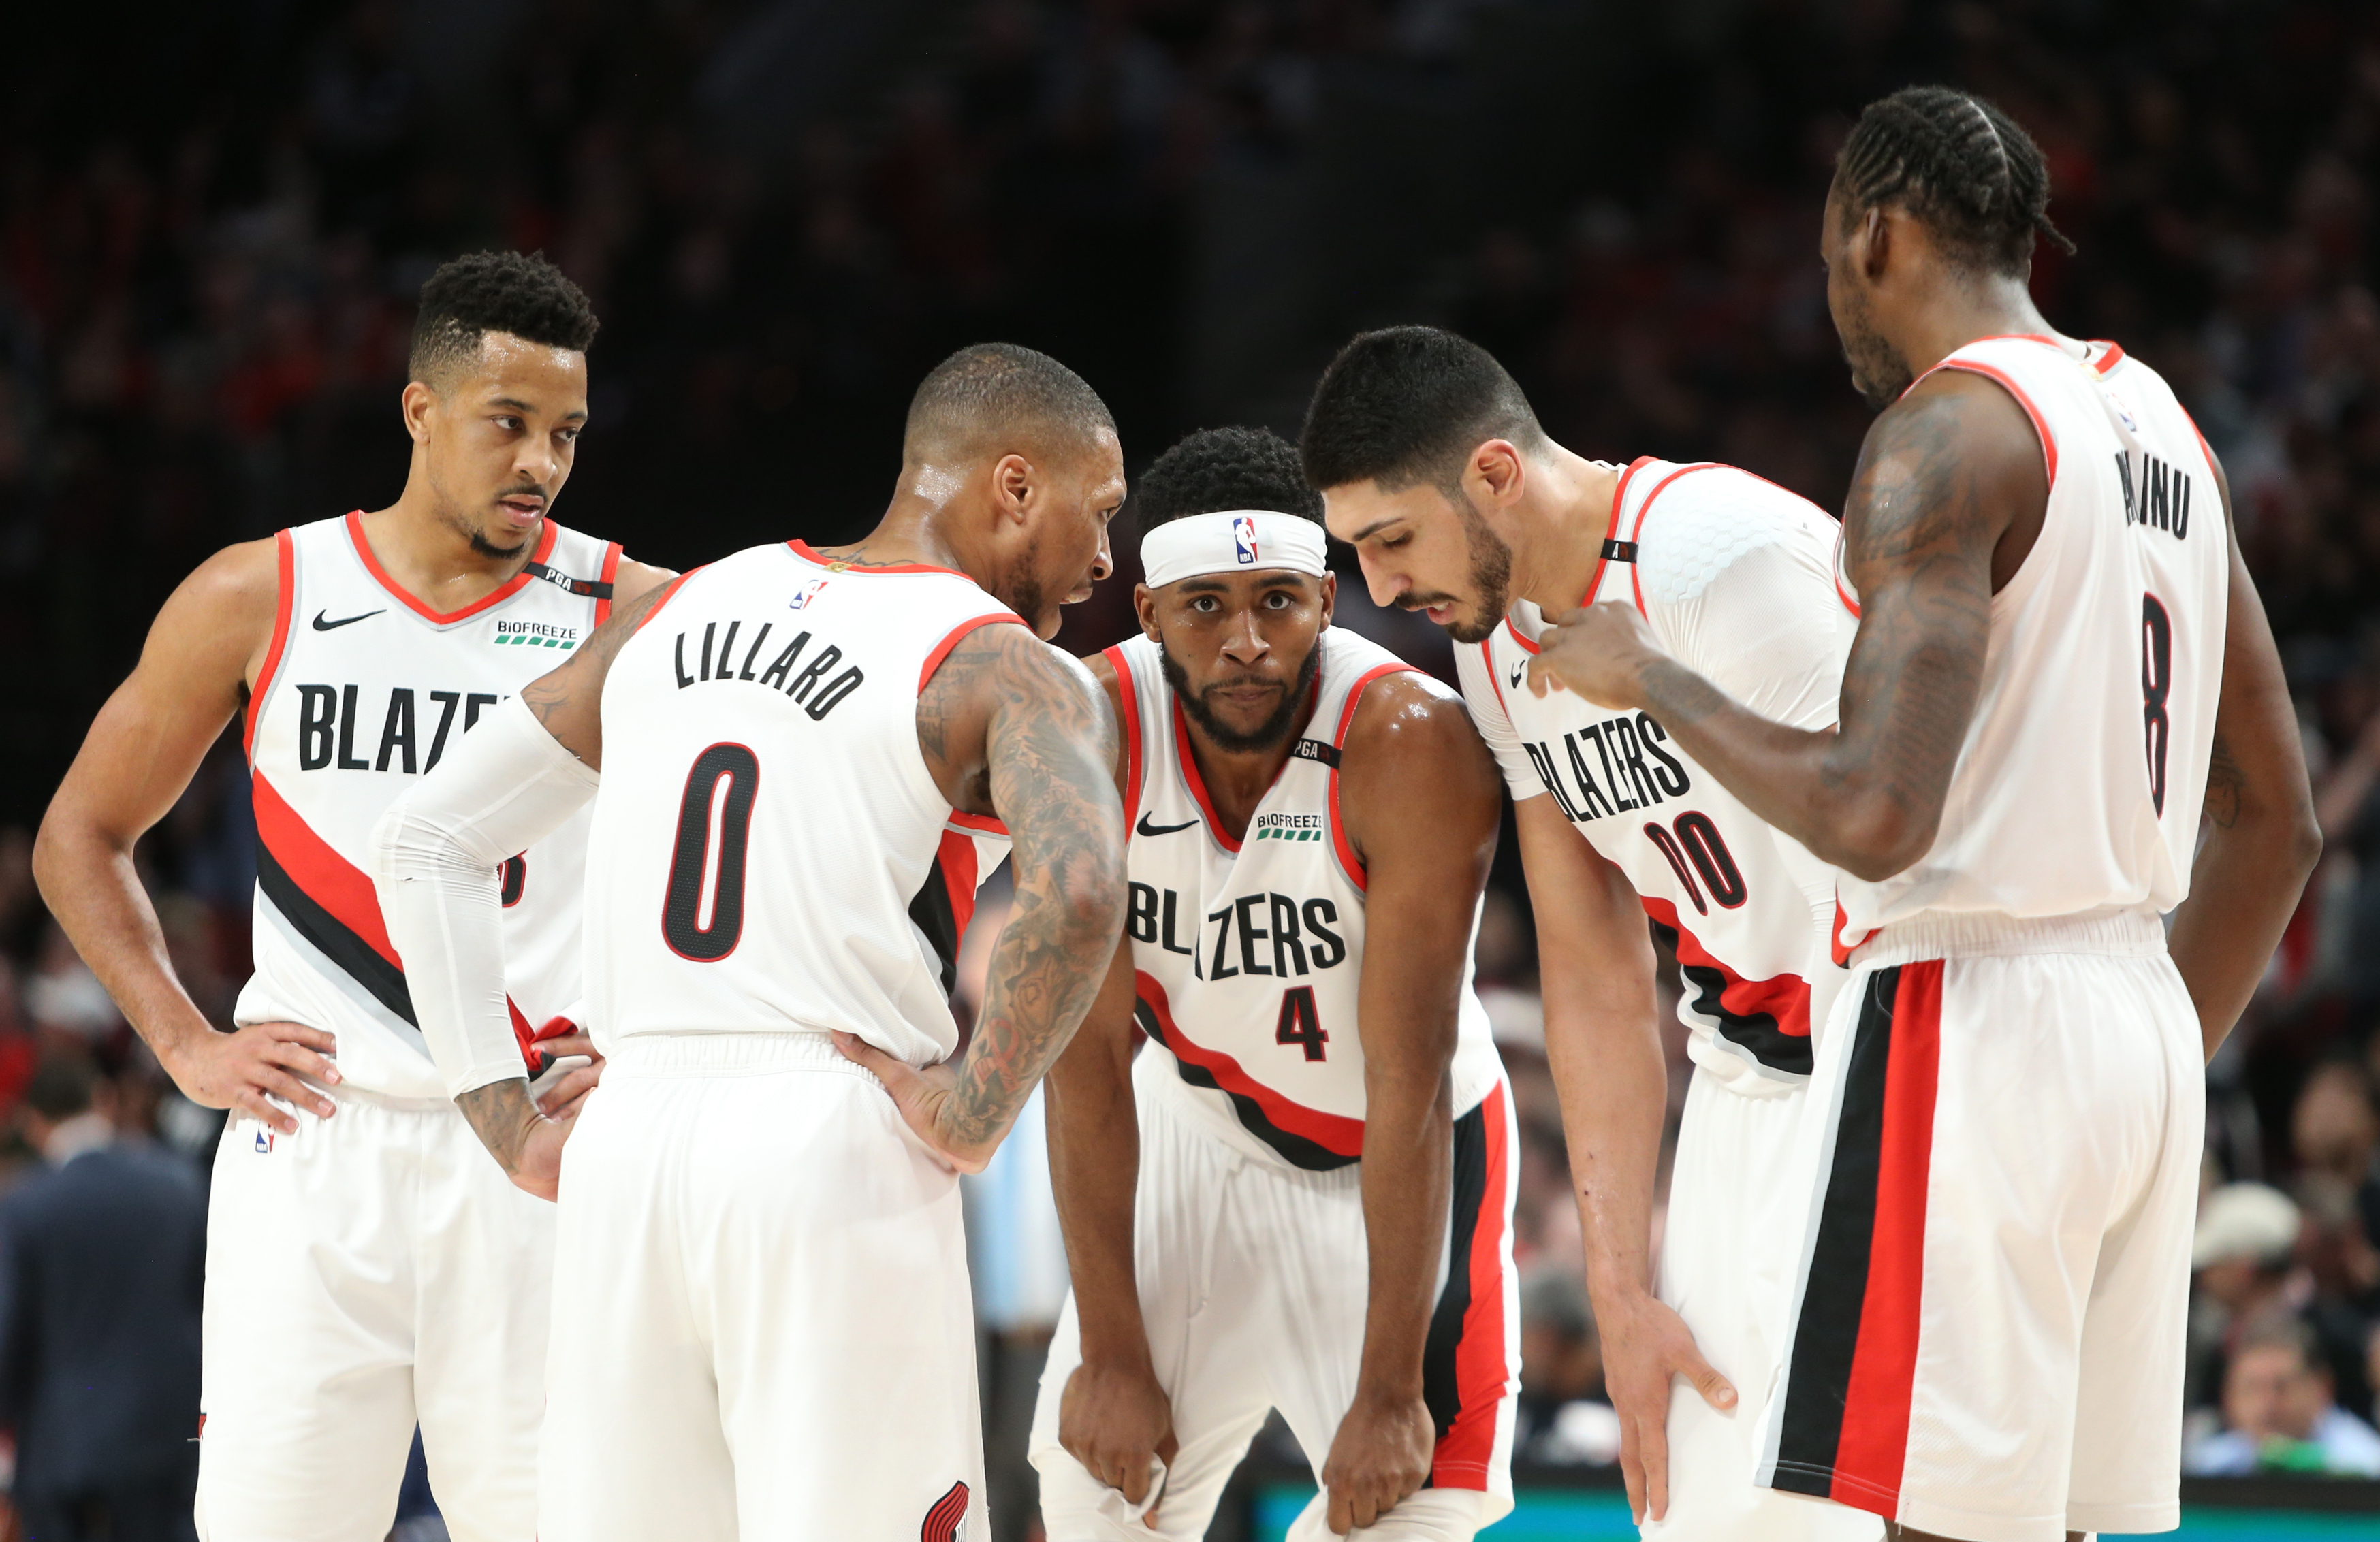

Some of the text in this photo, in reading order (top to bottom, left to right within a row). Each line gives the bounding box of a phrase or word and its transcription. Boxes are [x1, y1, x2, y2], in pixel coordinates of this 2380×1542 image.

[2115, 450, 2191, 540] AINU
[545, 568, 572, 591] PGA
[1239, 553, 1252, 562] NBA
[675, 620, 864, 721] LILLARD
[2142, 591, 2172, 820] 8
[1521, 711, 1691, 822] BLAZERS
[661, 741, 760, 963] 0
[1643, 810, 1748, 916] 00
[1128, 881, 1346, 982] BLZERS
[1275, 985, 1329, 1063] 4
